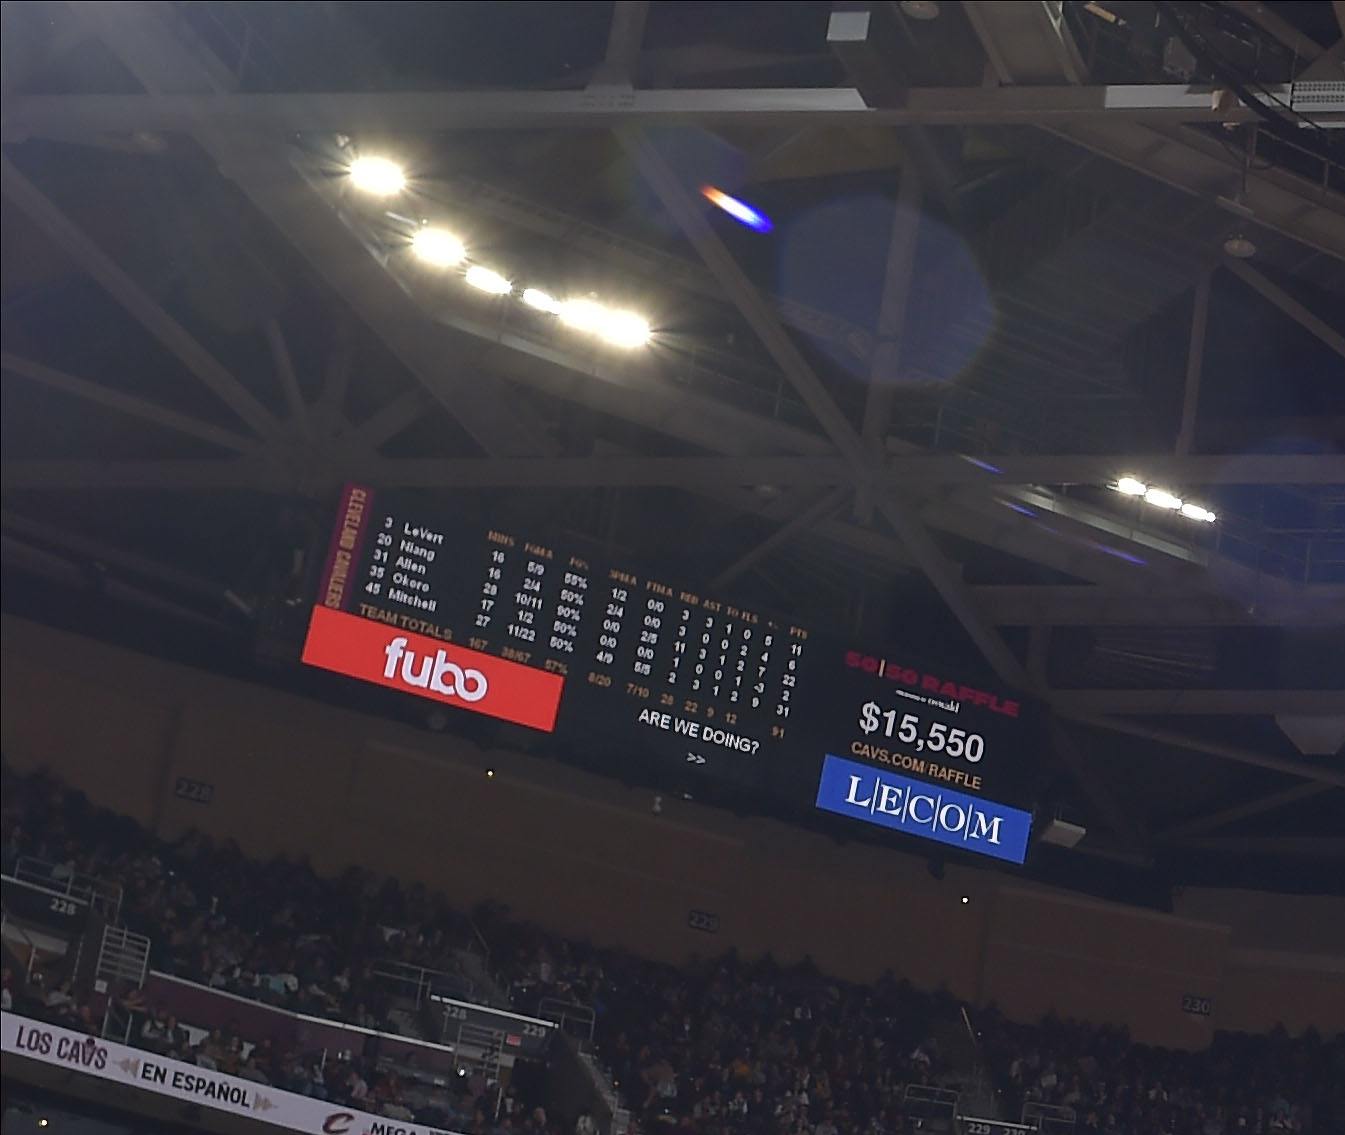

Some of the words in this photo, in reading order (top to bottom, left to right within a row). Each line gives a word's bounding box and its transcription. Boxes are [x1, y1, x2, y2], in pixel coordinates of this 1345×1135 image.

[403, 522, 444, 545] LeVert
[396, 556, 427, 575] Allen
[400, 540, 436, 562] Niang
[392, 572, 430, 593] Okoro
[388, 587, 438, 612] Mitchell
[360, 603, 399, 624] TEAM
[402, 615, 454, 640] TOTALS
[383, 637, 489, 702] fubo
[638, 708, 672, 730] ARE
[674, 717, 700, 738] WE
[702, 727, 761, 755] DOING?
[858, 701, 985, 763] $15,550
[16, 1025, 53, 1055] LOS
[57, 1037, 108, 1070] CAVS
[141, 1062, 168, 1085] EN
[171, 1071, 251, 1108] ESPAÑOL
